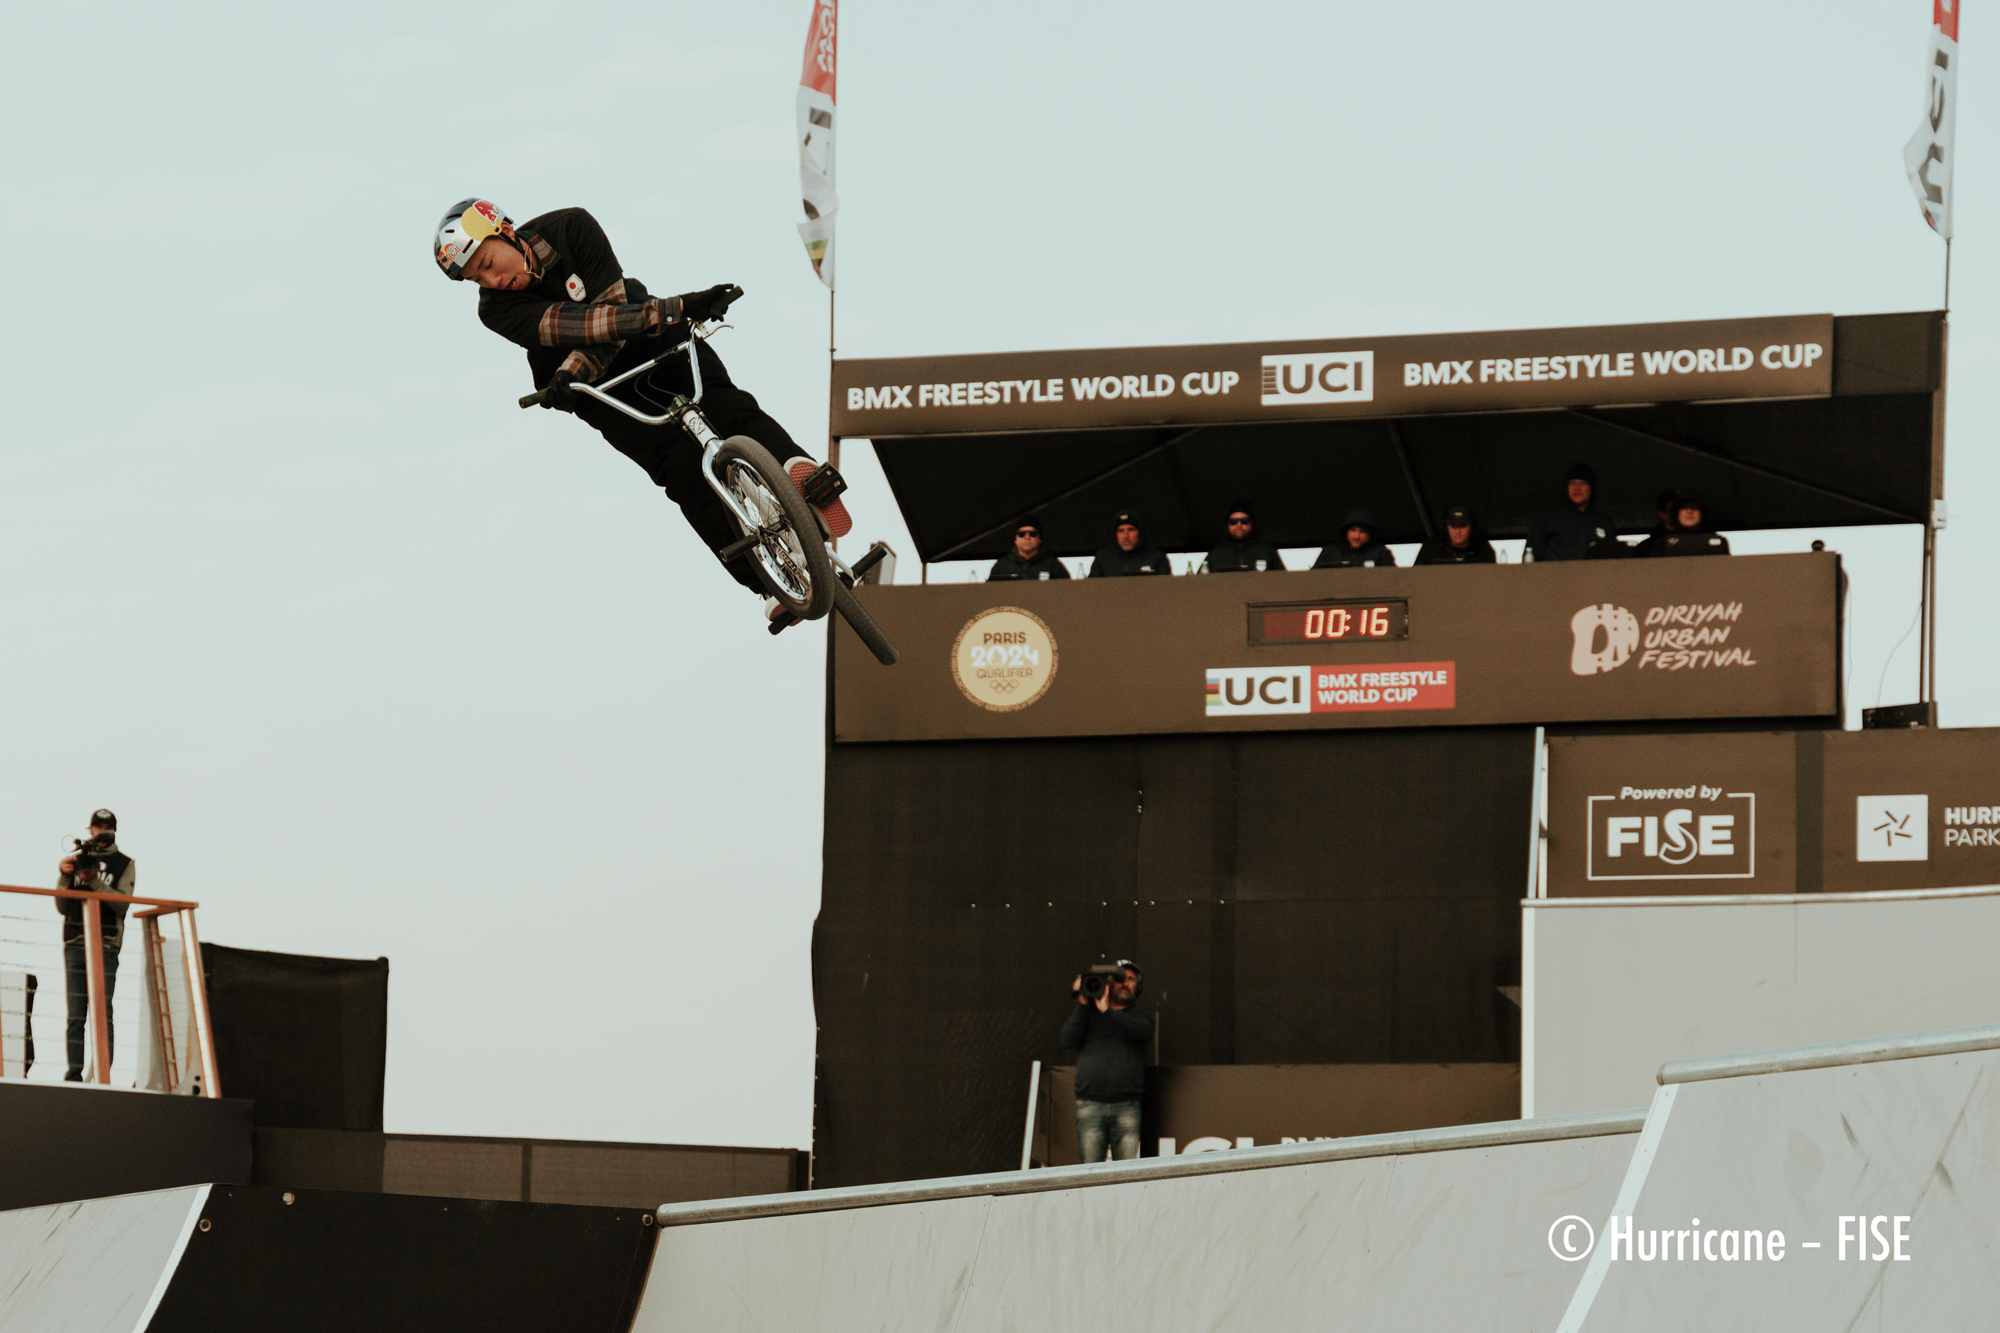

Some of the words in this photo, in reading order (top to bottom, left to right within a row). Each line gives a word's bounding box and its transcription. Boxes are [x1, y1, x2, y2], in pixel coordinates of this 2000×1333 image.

[1403, 361, 1473, 386] BMX
[1480, 353, 1634, 381] FREESTYLE
[1642, 347, 1754, 375] WORLD
[1760, 343, 1824, 369] CUP
[1282, 361, 1364, 394] UCI
[847, 384, 913, 411] BMX
[918, 378, 1064, 408] FREESTYLE
[1070, 373, 1176, 401] WORLD
[1181, 370, 1240, 397] CUP
[1305, 607, 1388, 638] 00:16
[1645, 602, 1742, 626] DIRIYAH
[984, 632, 1026, 644] PARIS
[1644, 626, 1731, 649] URBAN
[970, 645, 1039, 667] 2024
[1638, 647, 1757, 671] FESTIVAL
[977, 668, 1033, 678] QUALIFIER
[1318, 675, 1357, 688] BMX
[1361, 671, 1447, 687] FREESTYLE
[1224, 675, 1302, 707] UCI
[1317, 689, 1381, 705] WORLD
[1383, 687, 1418, 703] CUP
[1620, 785, 1696, 800] Powered
[1699, 785, 1723, 801] by
[1607, 808, 1735, 865] FISE
[1945, 828, 2000, 846] PARK
